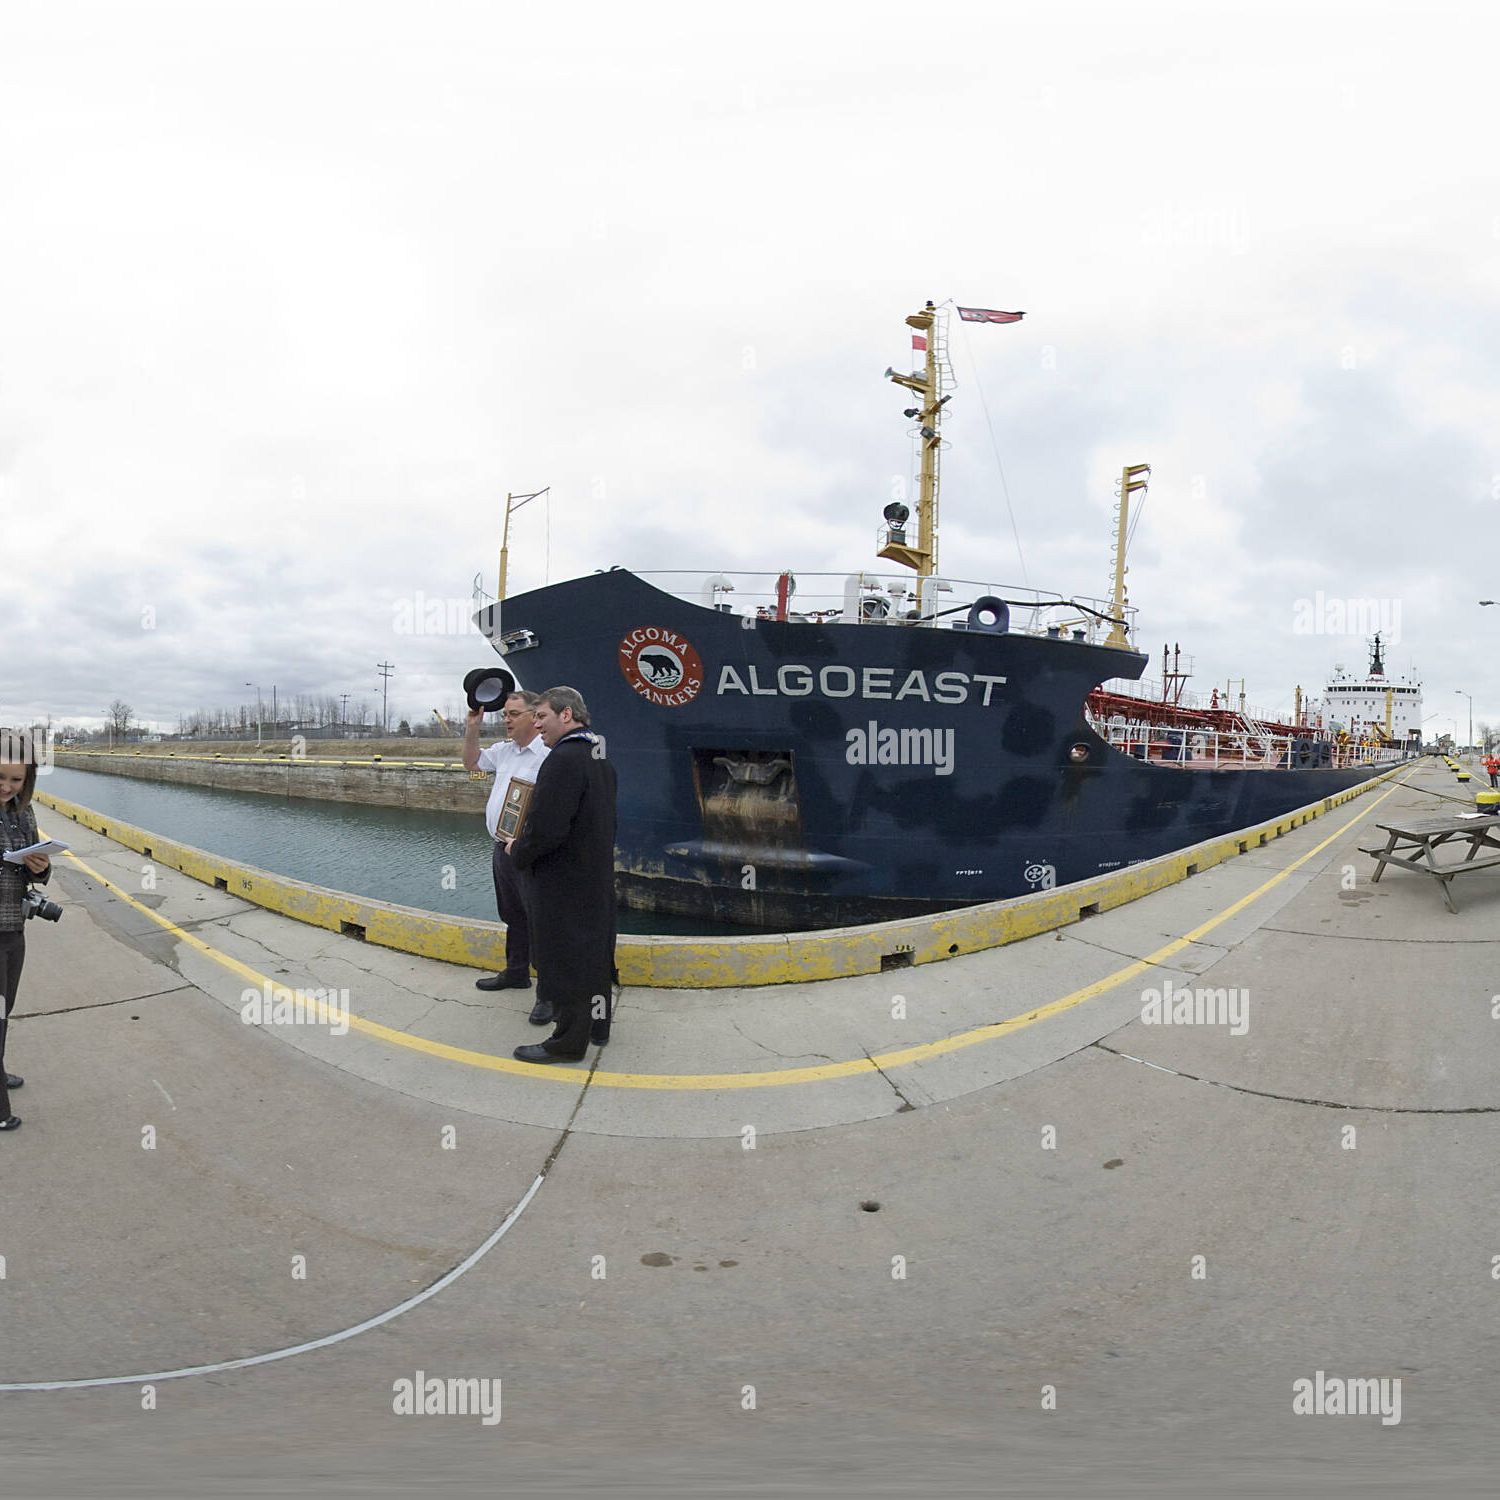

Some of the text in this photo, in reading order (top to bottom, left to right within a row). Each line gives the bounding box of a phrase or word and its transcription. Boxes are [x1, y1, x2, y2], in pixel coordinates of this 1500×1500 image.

[621, 627, 688, 660] ALGOMA
[633, 677, 700, 706] TANKERS
[716, 664, 1007, 706] ALGOEAST
